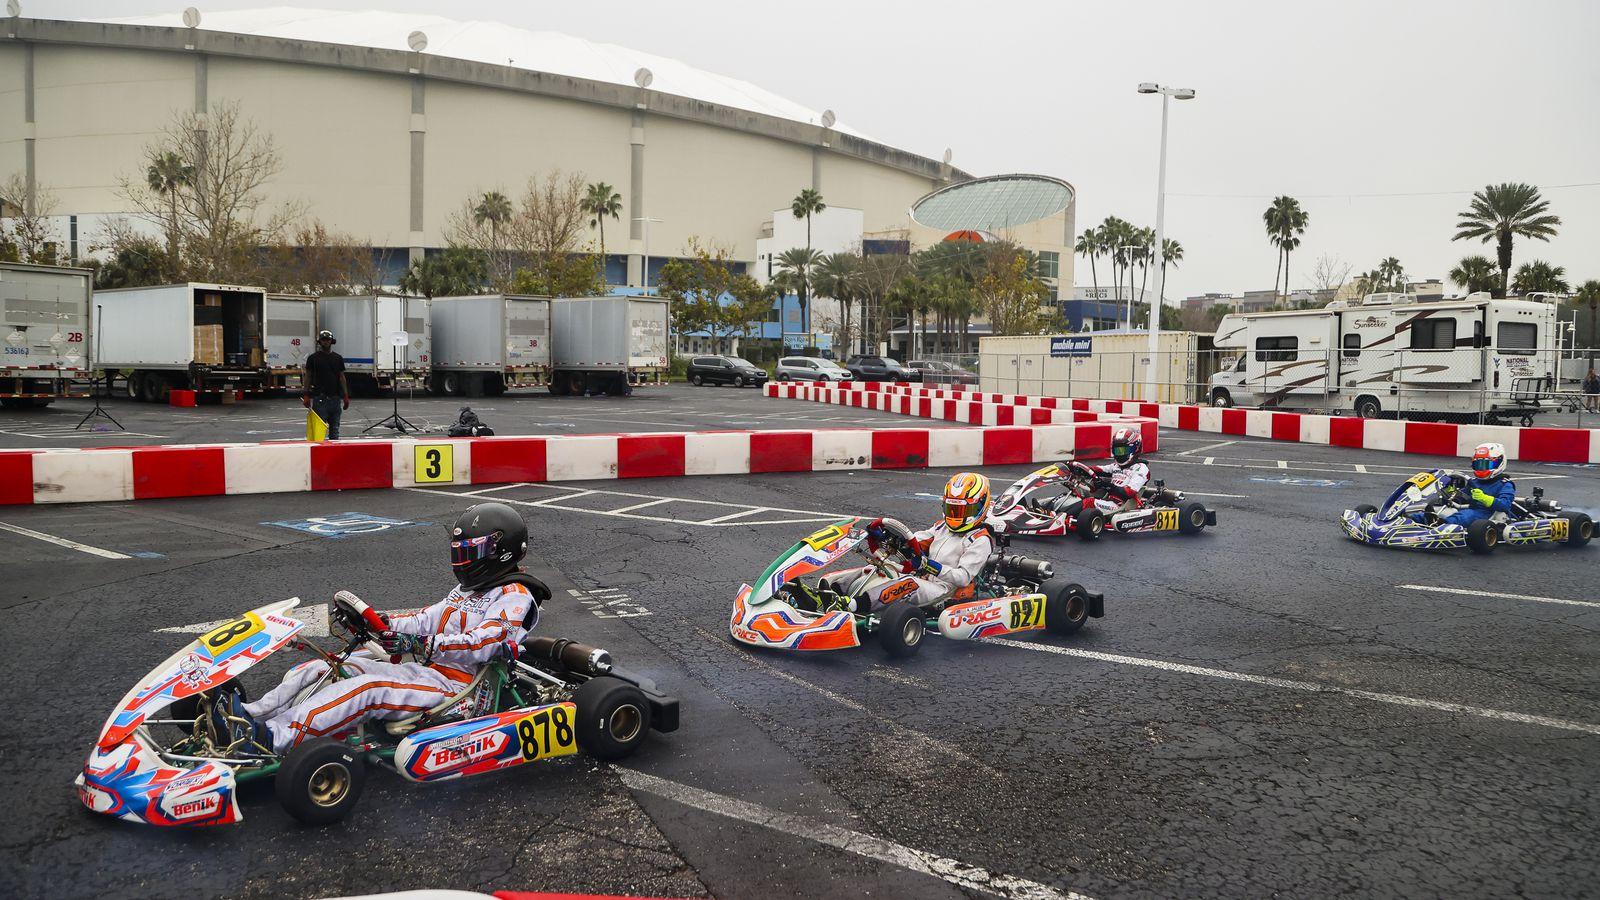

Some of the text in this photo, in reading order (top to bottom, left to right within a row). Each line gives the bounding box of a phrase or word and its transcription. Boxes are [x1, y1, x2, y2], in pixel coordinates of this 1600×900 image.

[1353, 319, 1387, 330] Sunseeker
[67, 332, 83, 343] 2B
[290, 338, 301, 346] 4B
[529, 339, 538, 348] 3B
[1052, 339, 1091, 350] mobile mini
[419, 355, 428, 363] 1B
[425, 449, 441, 478] 3
[1157, 511, 1176, 529] 811
[1010, 598, 1043, 629] 827
[208, 620, 252, 647] 8
[518, 707, 574, 761] 878
